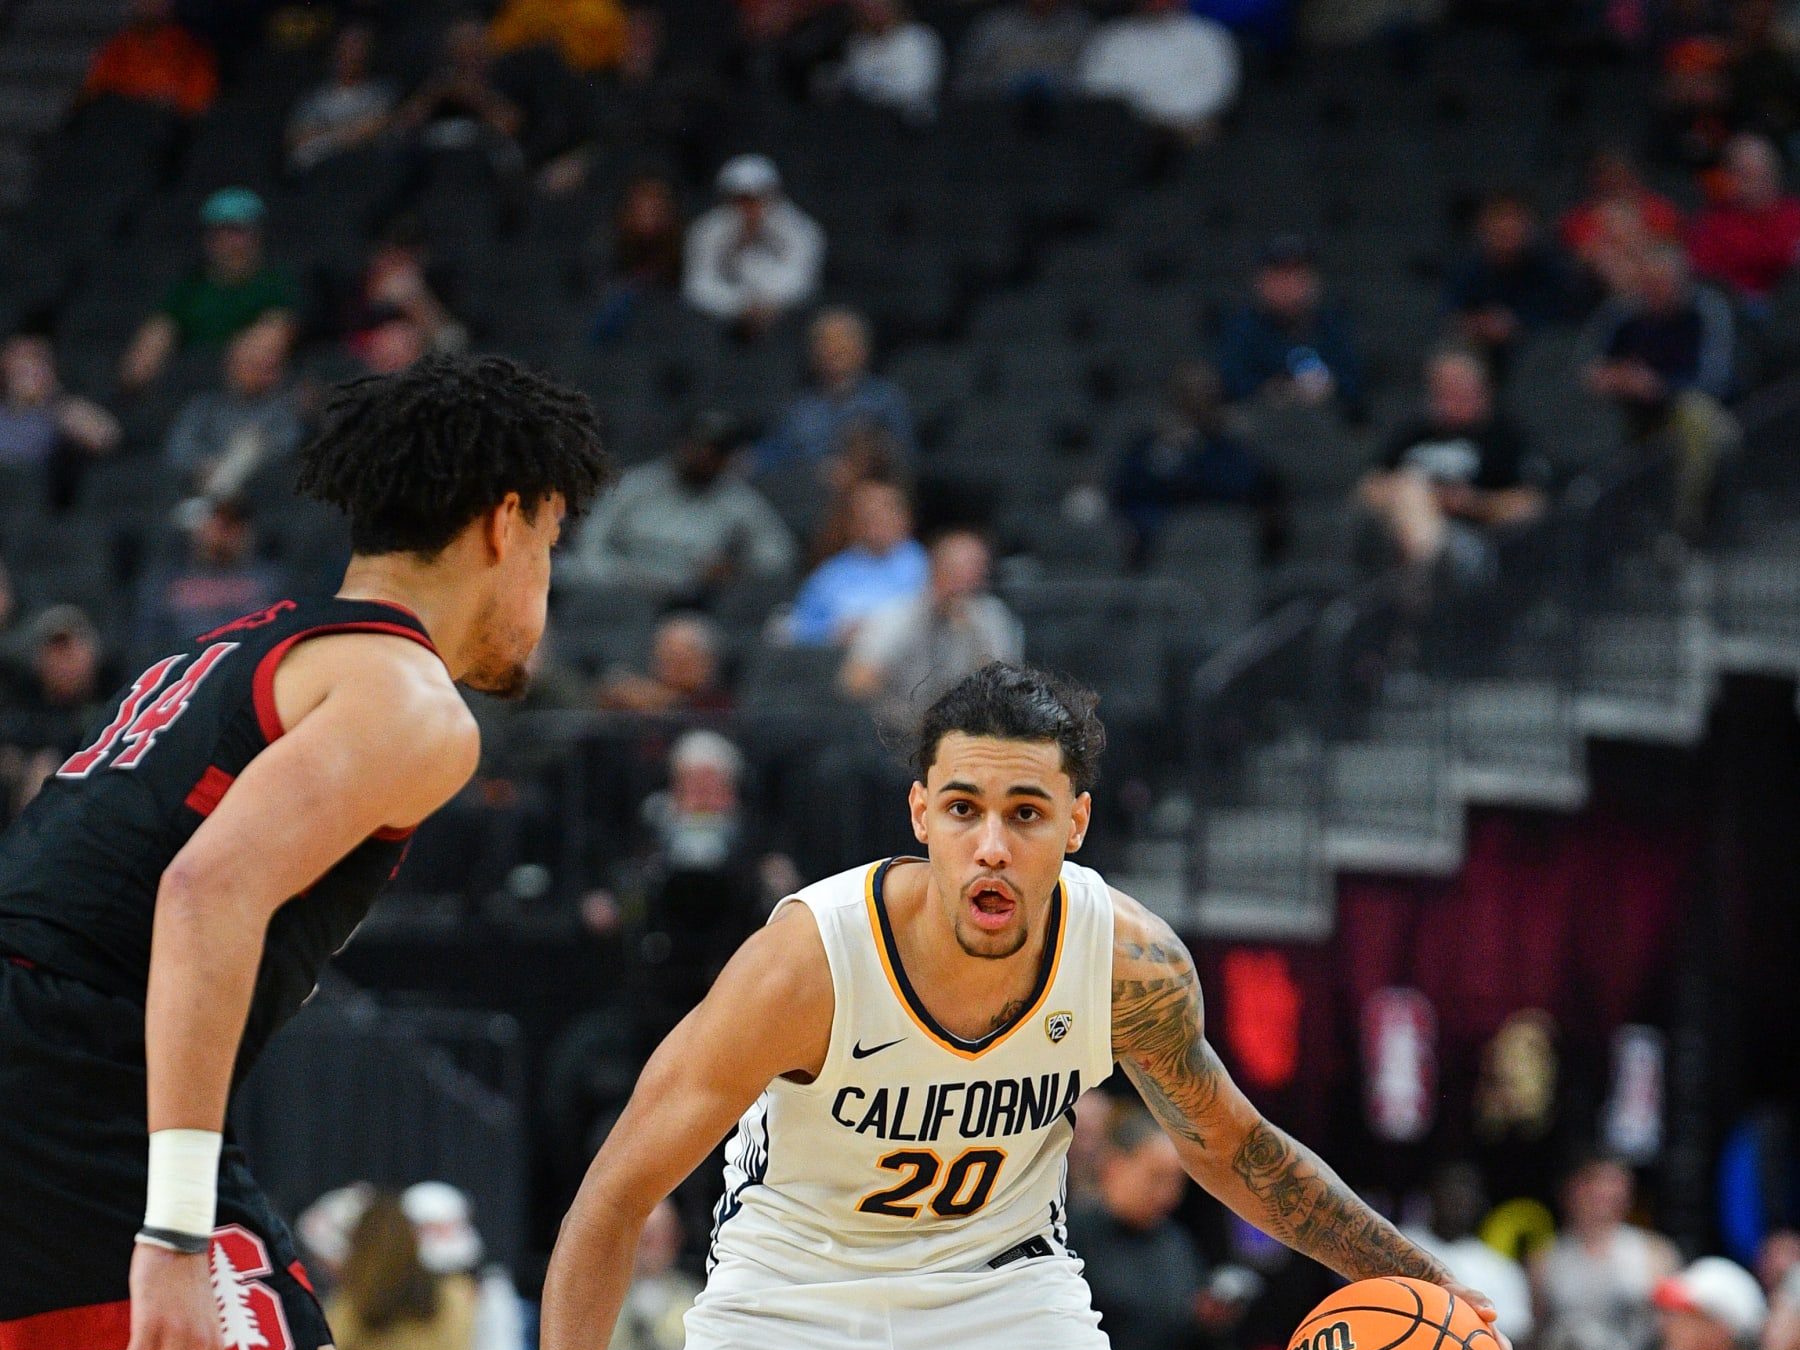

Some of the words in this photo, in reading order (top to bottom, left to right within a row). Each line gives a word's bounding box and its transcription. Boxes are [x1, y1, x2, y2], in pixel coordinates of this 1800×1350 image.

[56, 641, 241, 779] 14
[831, 1069, 1081, 1142] CALIFORNIA
[855, 1147, 1008, 1219] 20
